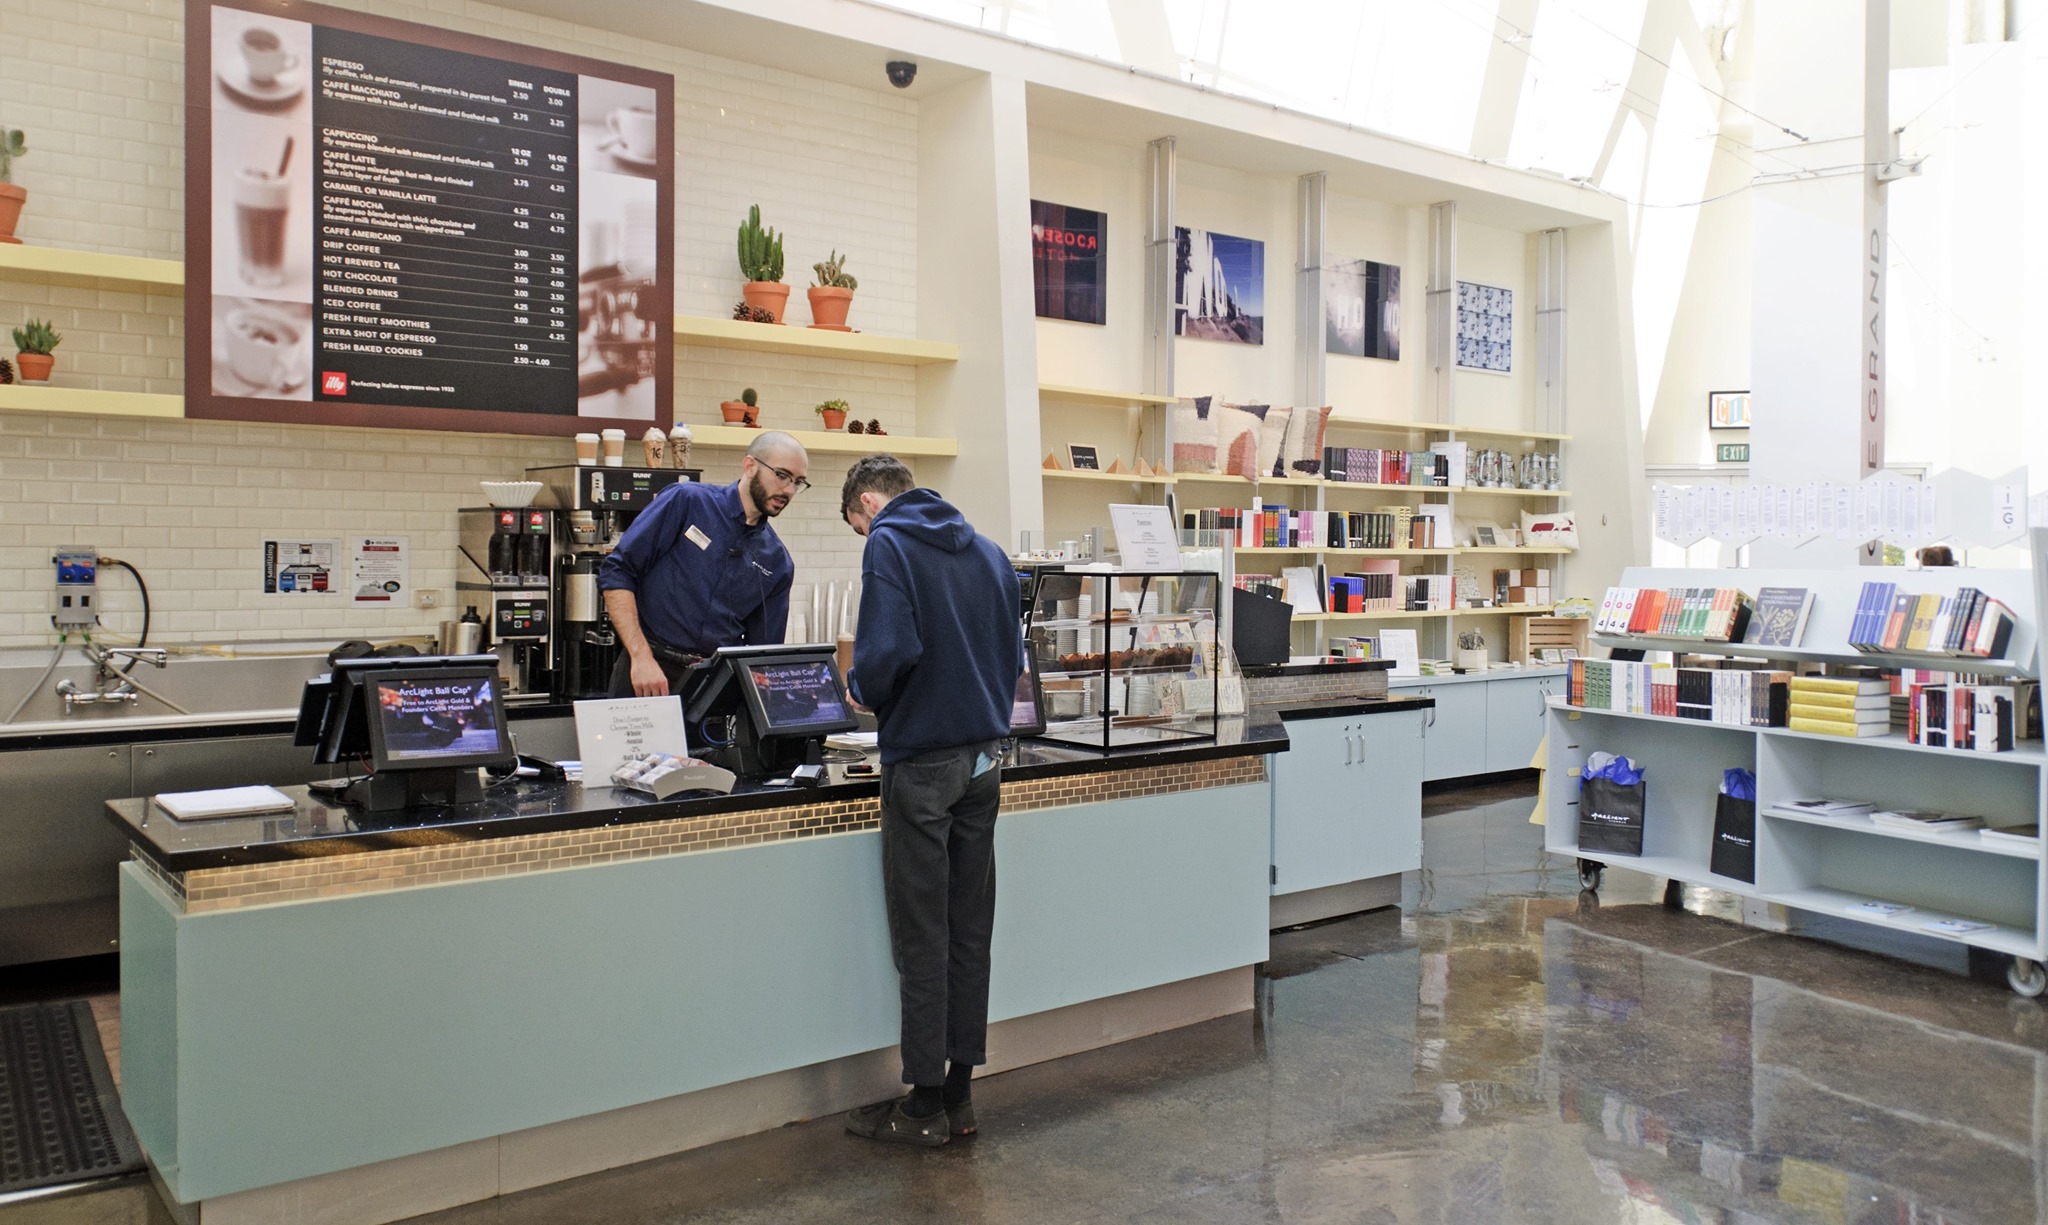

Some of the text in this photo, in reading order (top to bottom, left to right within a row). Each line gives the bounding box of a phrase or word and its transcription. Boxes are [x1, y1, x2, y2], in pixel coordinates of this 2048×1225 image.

[322, 57, 364, 71] ESPRESSO
[351, 84, 401, 100] MACCHIATO
[360, 72, 373, 80] rich
[374, 76, 388, 84] and
[421, 84, 452, 94] prepared
[491, 95, 507, 104] form
[508, 79, 570, 96] SINGLE DOUBLE
[335, 91, 366, 102] espresso
[366, 96, 382, 104] with
[389, 100, 408, 109] touch
[418, 105, 447, 115] steamed
[448, 110, 460, 118] and
[513, 91, 563, 106] 2.50 3.00
[513, 112, 565, 128] 2.75 3.25
[323, 128, 378, 143] CAPPUCCINO
[335, 140, 366, 150] espresso
[367, 143, 396, 154] blended
[396, 148, 411, 156] with
[352, 155, 377, 165] LATTE
[520, 150, 532, 158] OZ
[557, 155, 567, 163] OZ
[335, 162, 366, 172] espresso
[389, 169, 404, 177] with
[405, 171, 418, 179] hot
[514, 157, 564, 172] 3.75 4.25
[323, 168, 339, 176] with
[340, 170, 354, 178] rich
[355, 172, 372, 181] layer
[323, 181, 437, 203] CARAMEL OR VANILLA LATTE
[513, 178, 565, 193] 3.75 4.25
[352, 200, 384, 210] MOCHA
[335, 207, 366, 216] espresso
[367, 210, 396, 220] blended
[397, 214, 412, 222] with
[412, 215, 429, 224] thick
[430, 218, 462, 228] chocolate
[513, 207, 565, 220] 4.25 4.75
[399, 222, 414, 230] with
[513, 221, 565, 234] 4.25 4.75
[352, 230, 402, 242] AMERICANO
[323, 240, 380, 254] DRIP COFFEE
[323, 255, 400, 270] HOT BREWED TEA
[514, 249, 565, 262] 3.00 3.50
[514, 262, 564, 275] 2.75 3.25
[323, 270, 398, 284] HOT CHOCOLATE
[514, 276, 564, 288] 3.00 4.00
[323, 284, 399, 298] BLENDED DRINKS
[514, 290, 564, 301] 3.00 3.50
[323, 298, 381, 311] ICED COFFEE
[514, 303, 528, 311] 4.25
[323, 312, 430, 329] FRESH FRUIT SMOOTHIES
[514, 316, 529, 324] 3.00
[1868, 228, 1880, 423] GRAND
[323, 327, 436, 344] EXTRA SHOT OF ESPRESSO
[323, 342, 423, 356] FRESH BAKED COOKIES
[326, 376, 345, 392] illy
[351, 380, 381, 389] Perfecting
[651, 447, 662, 459] 16
[1723, 446, 1745, 460] EXIT
[2003, 512, 2014, 524] G
[266, 544, 275, 578] sanitizing
[400, 688, 434, 697] ArcLight
